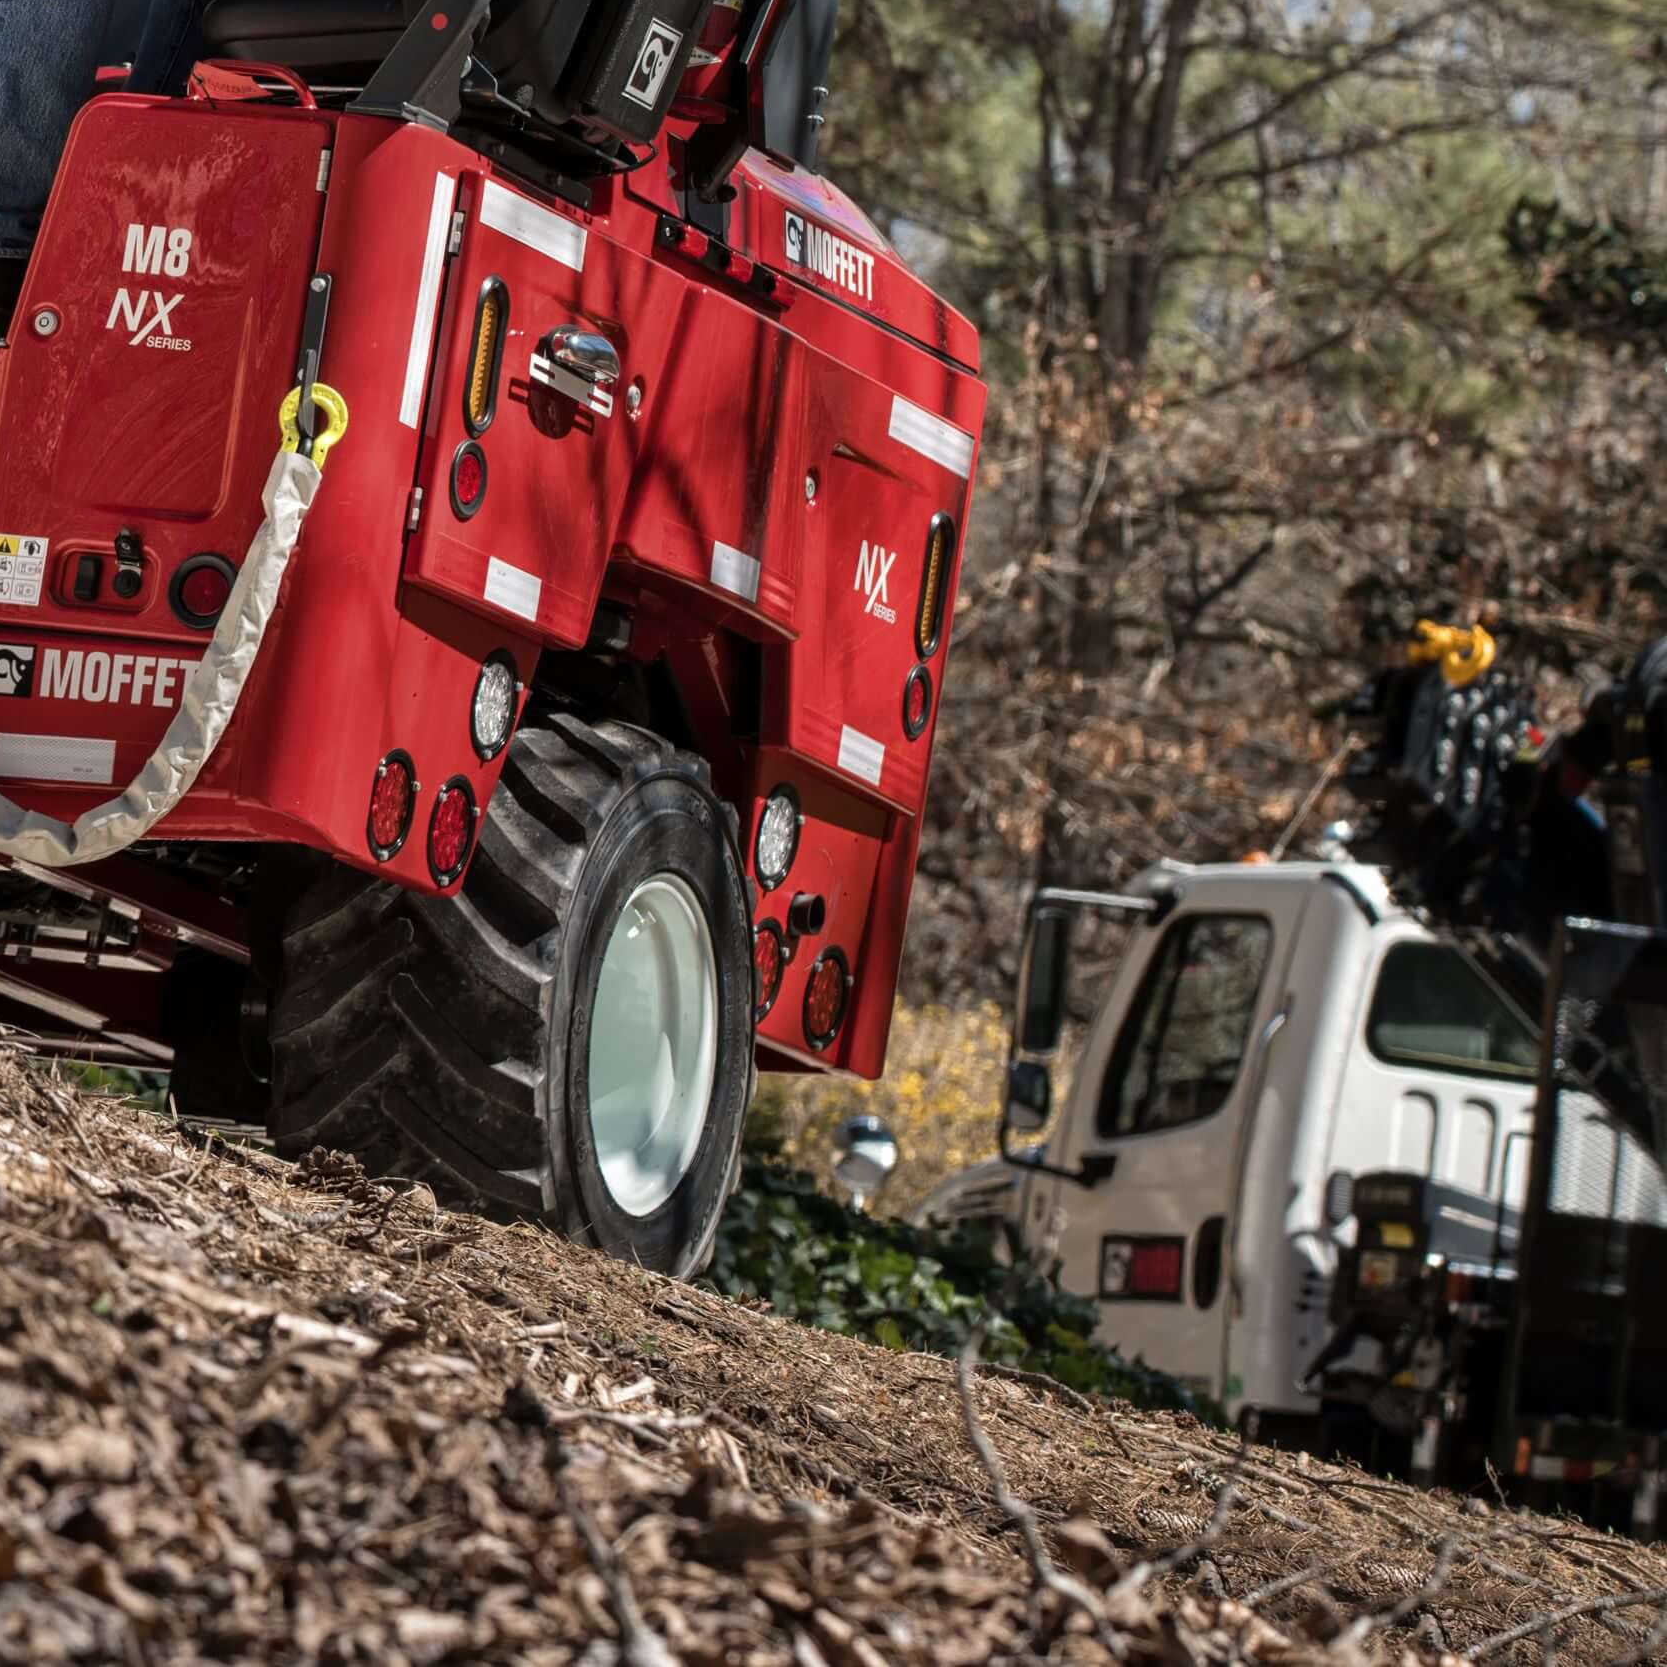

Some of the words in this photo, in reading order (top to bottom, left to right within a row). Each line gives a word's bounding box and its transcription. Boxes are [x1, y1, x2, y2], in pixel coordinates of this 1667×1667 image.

[122, 223, 193, 277] M8
[807, 220, 875, 301] MOFFETT
[105, 287, 185, 346] NX
[146, 335, 192, 351] SERIES
[854, 539, 897, 614] NX
[873, 602, 897, 624] SERIES
[39, 648, 203, 708] MOFFET
